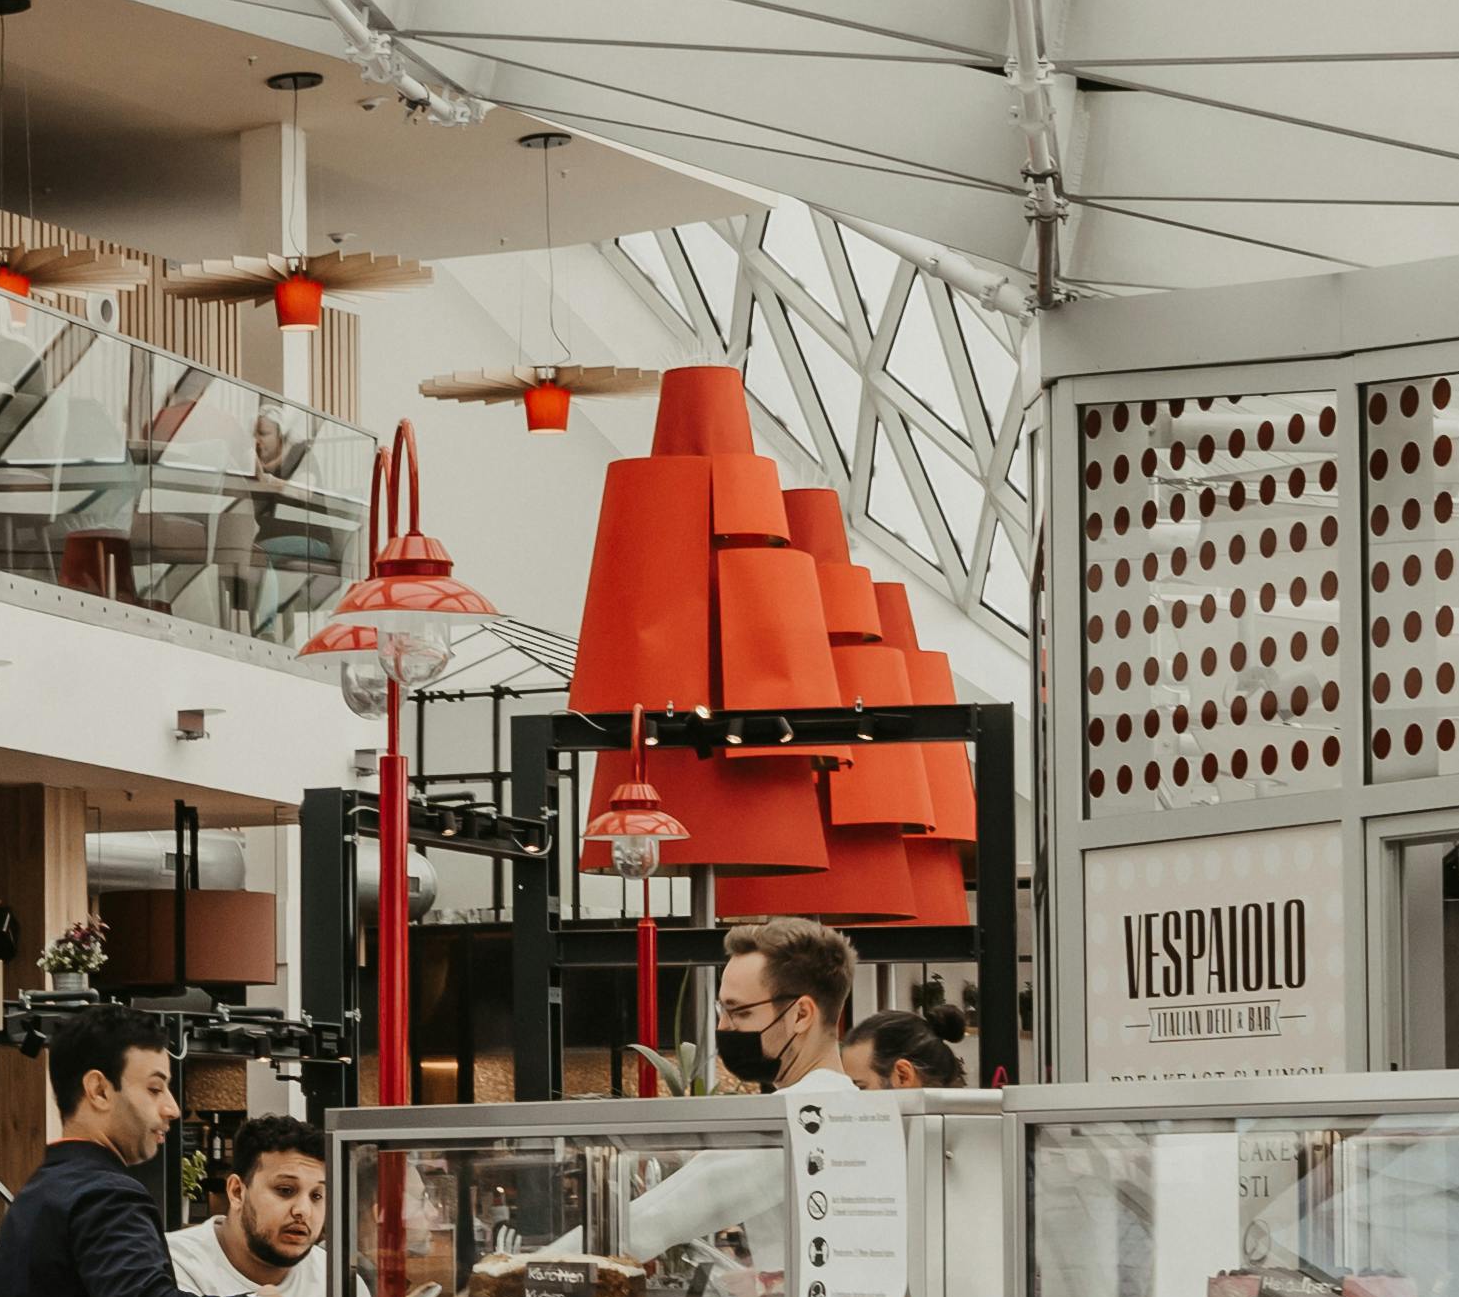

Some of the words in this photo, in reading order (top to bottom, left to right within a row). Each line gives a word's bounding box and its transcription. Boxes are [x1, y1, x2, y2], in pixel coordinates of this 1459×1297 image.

[1124, 899, 1306, 999] VESPAIOLO
[1158, 1010, 1201, 1037] ITALIAN
[1207, 1008, 1232, 1034] DELI
[1237, 1011, 1244, 1029] &
[1248, 1006, 1271, 1031] BAR
